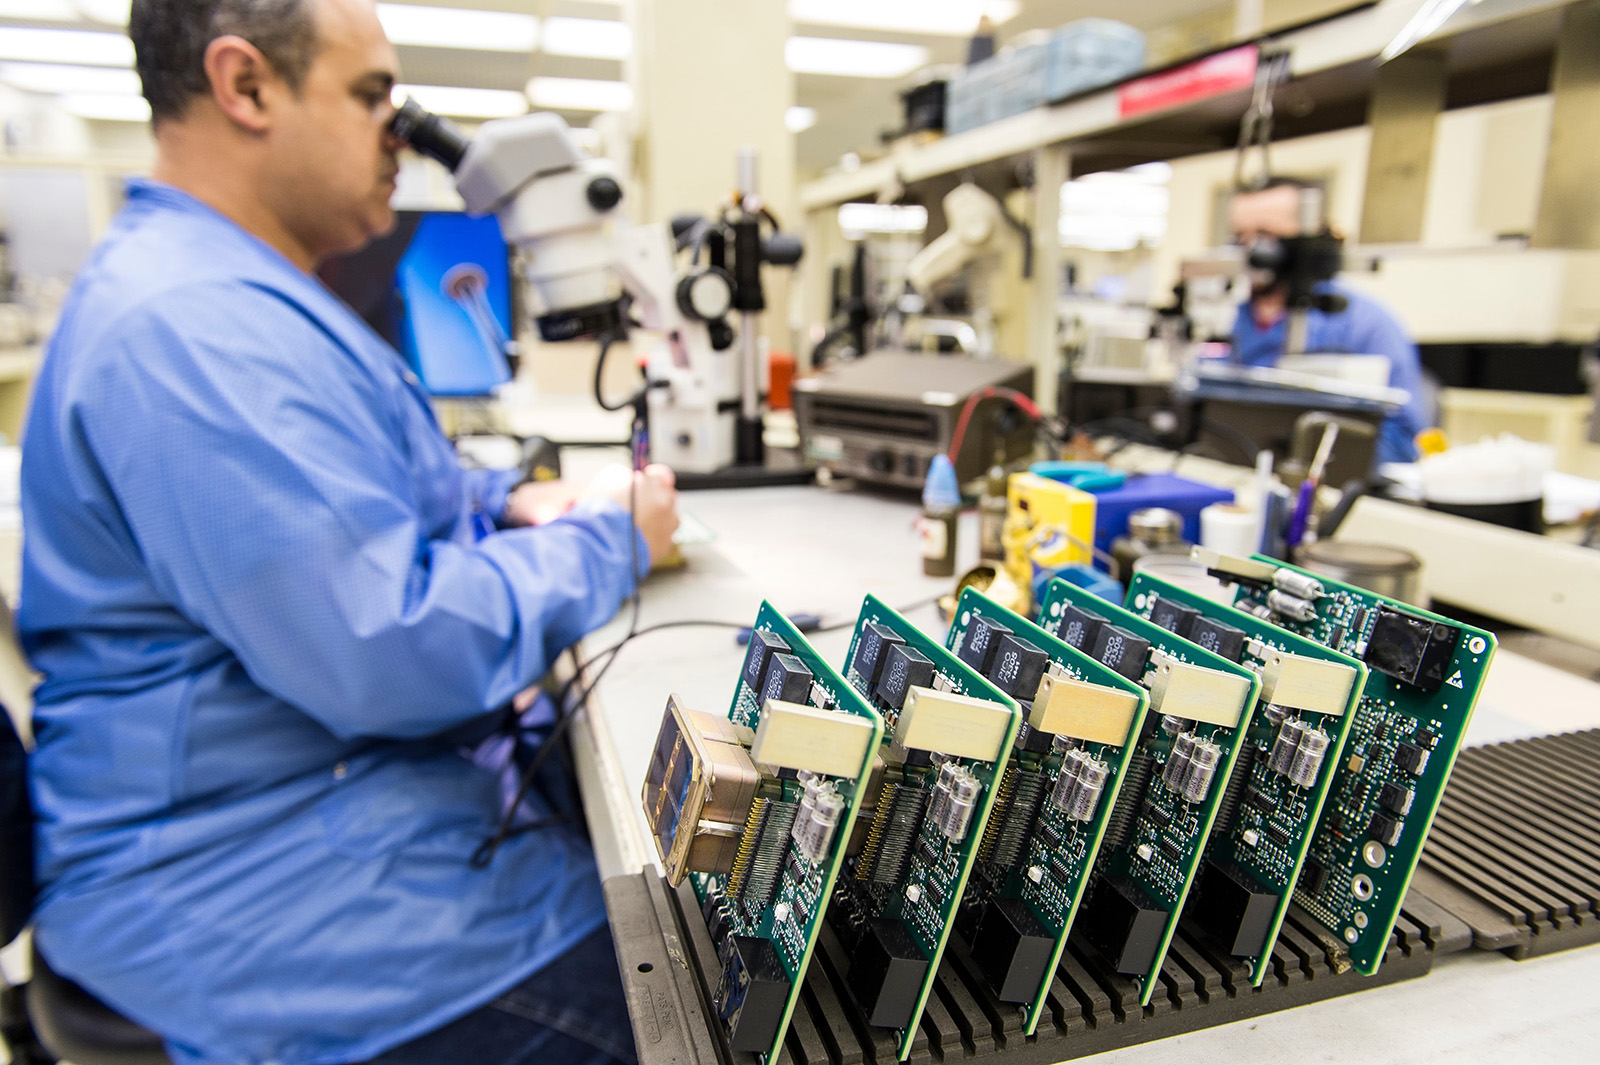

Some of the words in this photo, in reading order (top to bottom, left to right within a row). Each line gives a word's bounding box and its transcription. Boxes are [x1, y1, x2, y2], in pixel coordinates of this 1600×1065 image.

[862, 635, 874, 663] PICO
[866, 634, 878, 665] 73305
[970, 624, 982, 652] PICO
[976, 624, 988, 654] 73305
[1102, 636, 1115, 665] PICO
[1108, 636, 1122, 668] 73305
[886, 662, 898, 690] PICO
[890, 662, 904, 694] 73305
[998, 652, 1011, 680] PICO
[1004, 651, 1018, 683] 73305
